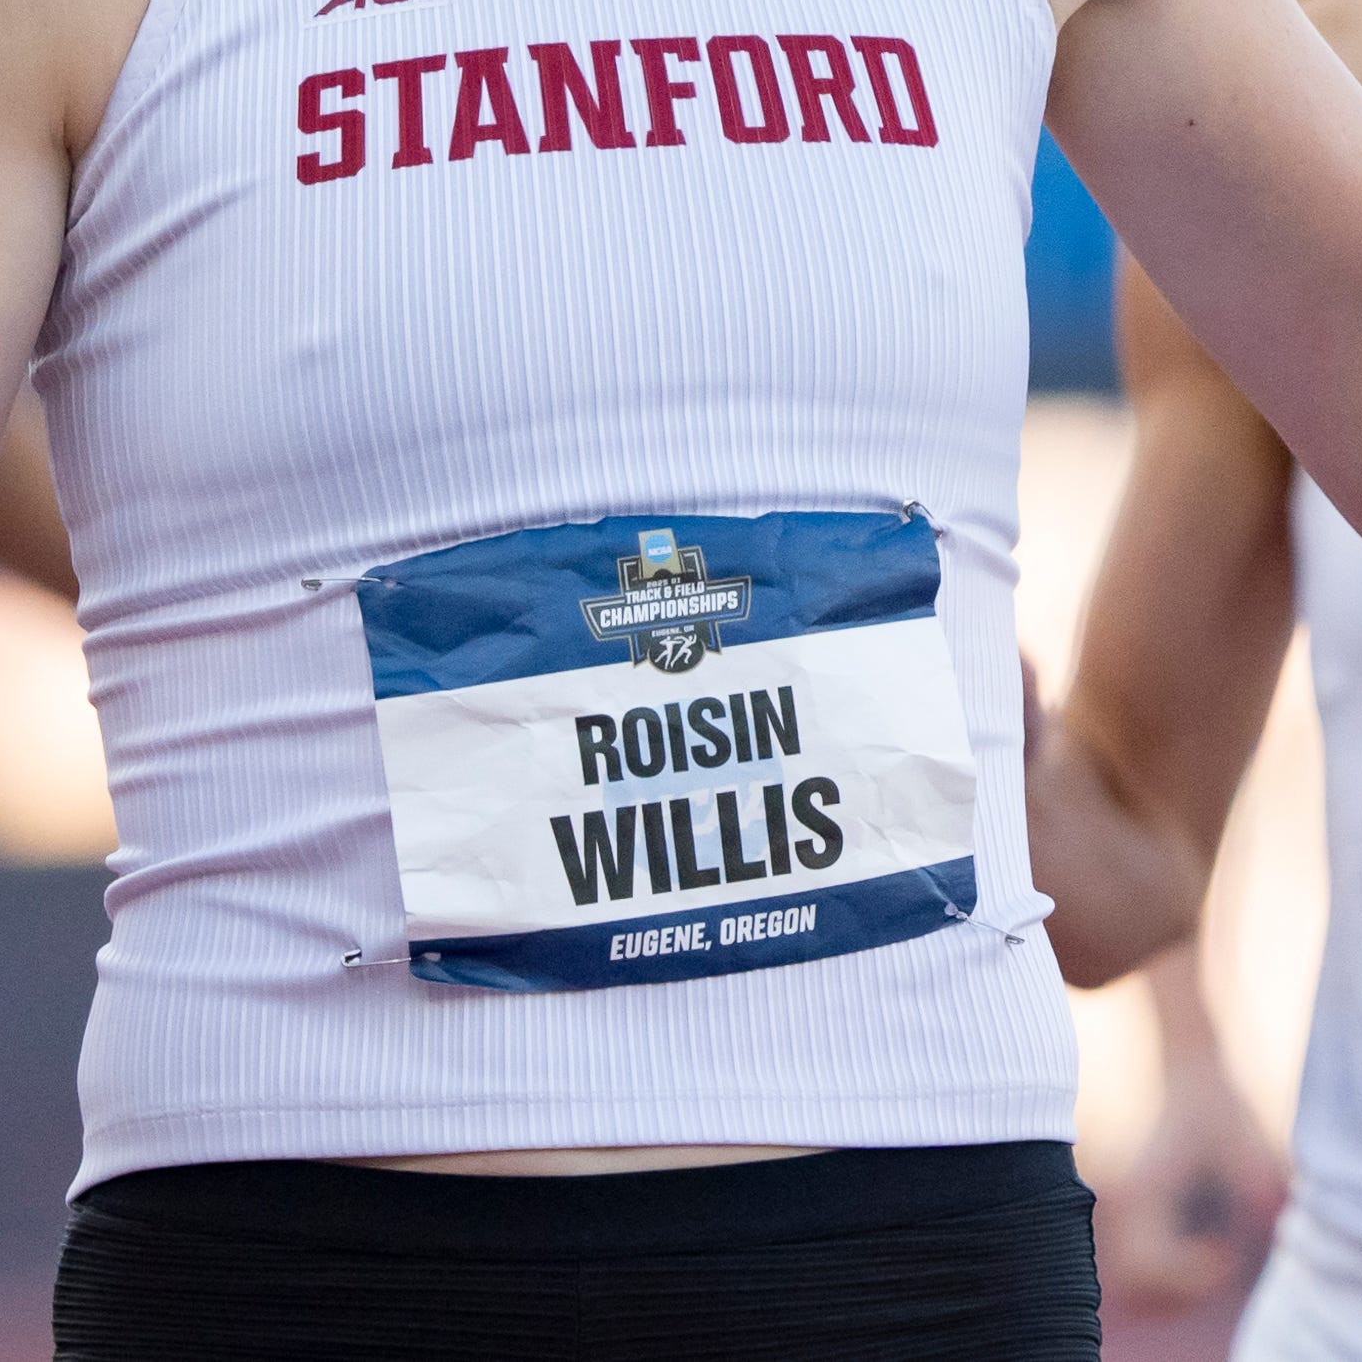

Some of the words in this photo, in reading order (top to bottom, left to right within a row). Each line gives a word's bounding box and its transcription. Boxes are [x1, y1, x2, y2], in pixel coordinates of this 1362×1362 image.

[296, 34, 940, 186] STANFORD
[599, 590, 739, 628] CHAMPIONSHIPS
[625, 588, 663, 604] TRACK
[663, 586, 673, 599] &
[674, 581, 706, 597] FIELD
[574, 685, 802, 786] ROISIN
[549, 776, 845, 907] WILLIS
[609, 924, 712, 961] EUGENE,
[720, 903, 818, 947] OREGON
